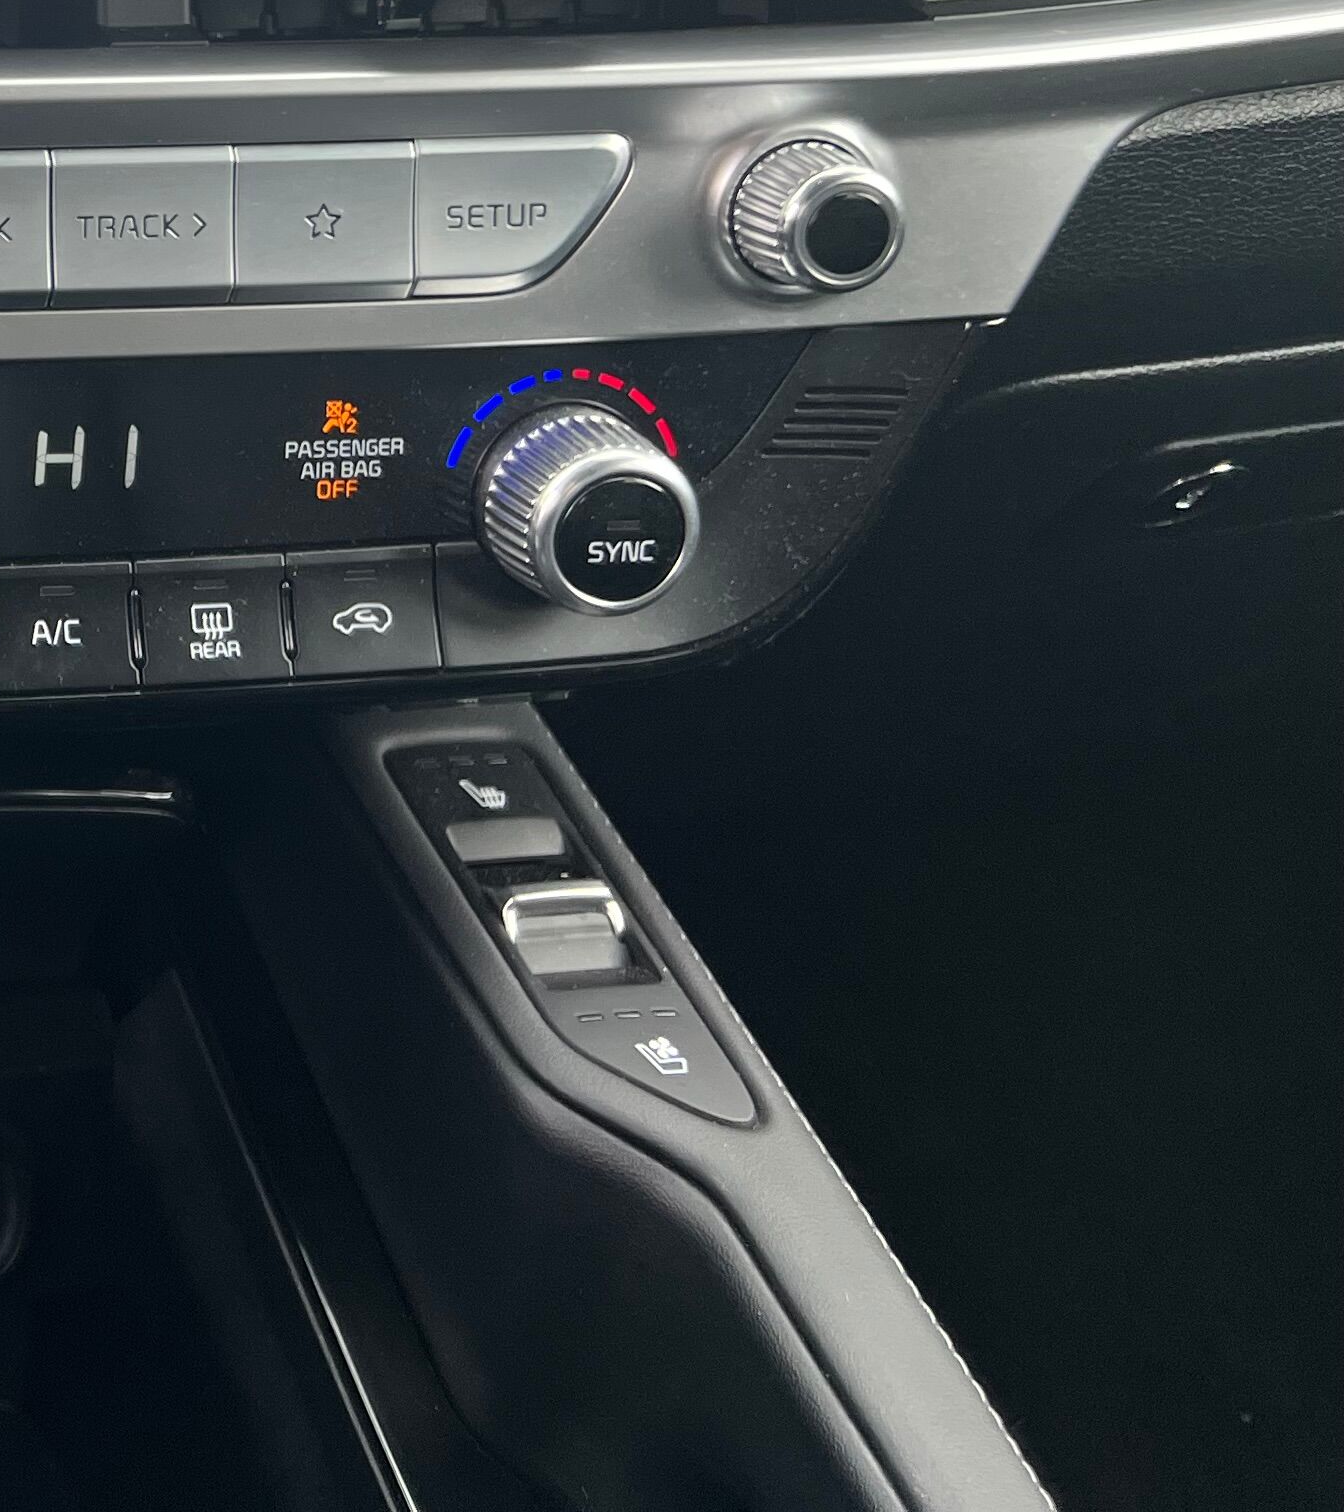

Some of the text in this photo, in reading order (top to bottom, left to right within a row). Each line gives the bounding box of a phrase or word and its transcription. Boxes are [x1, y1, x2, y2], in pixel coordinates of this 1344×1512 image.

[445, 202, 548, 231] SETUP
[284, 437, 404, 460] PASSENGER
[299, 459, 382, 480] AIR BAG
[316, 480, 359, 500] OFF
[587, 538, 655, 564] SYNC
[31, 618, 81, 647] A/C
[189, 638, 241, 659] REAR
